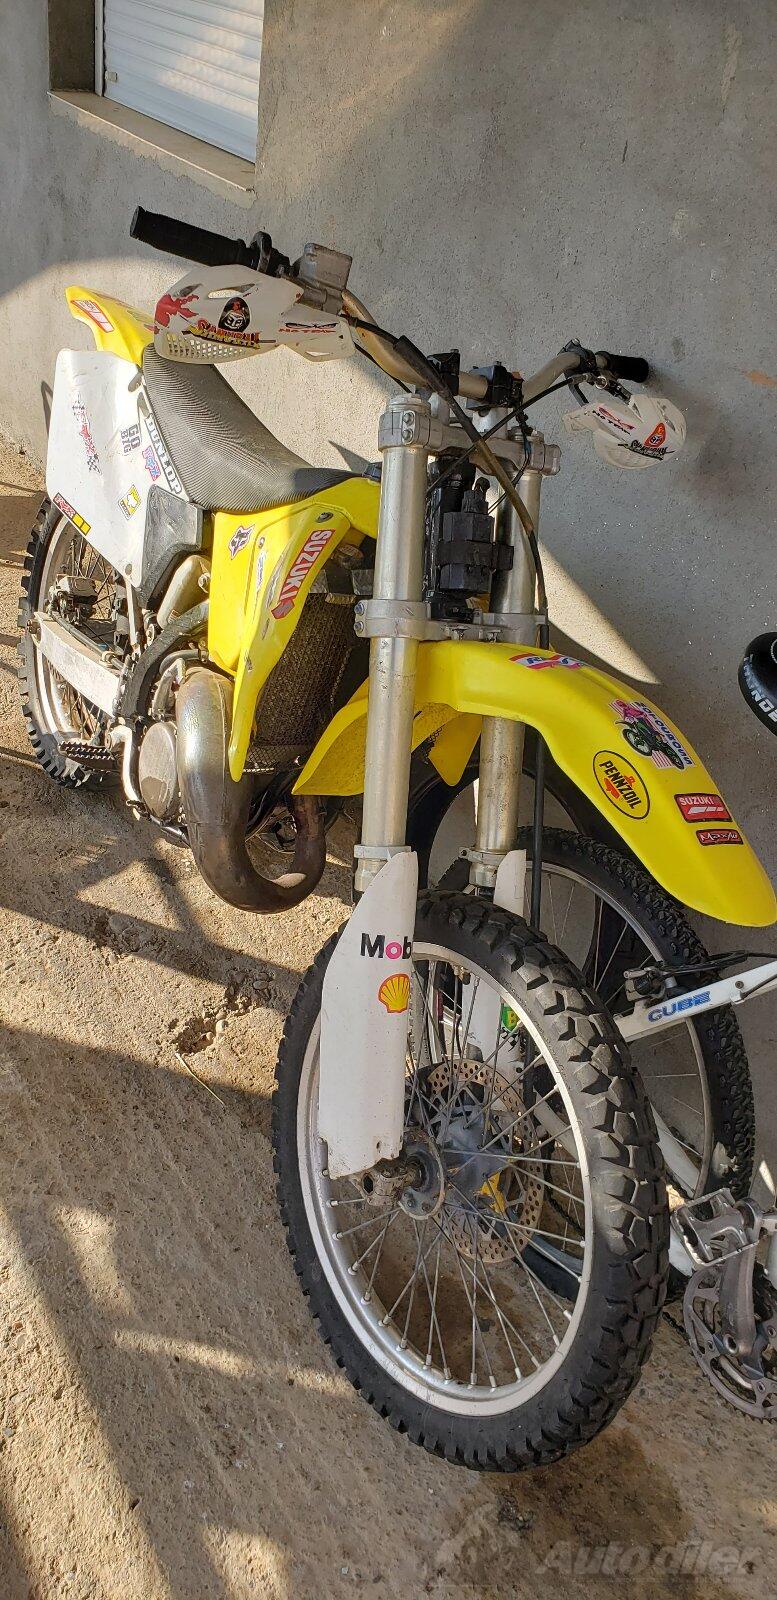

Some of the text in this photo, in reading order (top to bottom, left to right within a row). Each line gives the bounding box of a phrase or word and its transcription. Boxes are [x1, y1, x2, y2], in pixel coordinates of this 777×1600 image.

[145, 413, 182, 494] DUNLOP
[280, 530, 332, 600] SUZUKI
[600, 760, 642, 809] PENNZOIL
[679, 796, 714, 807] SUZUKI
[648, 991, 711, 1022] CUBE
